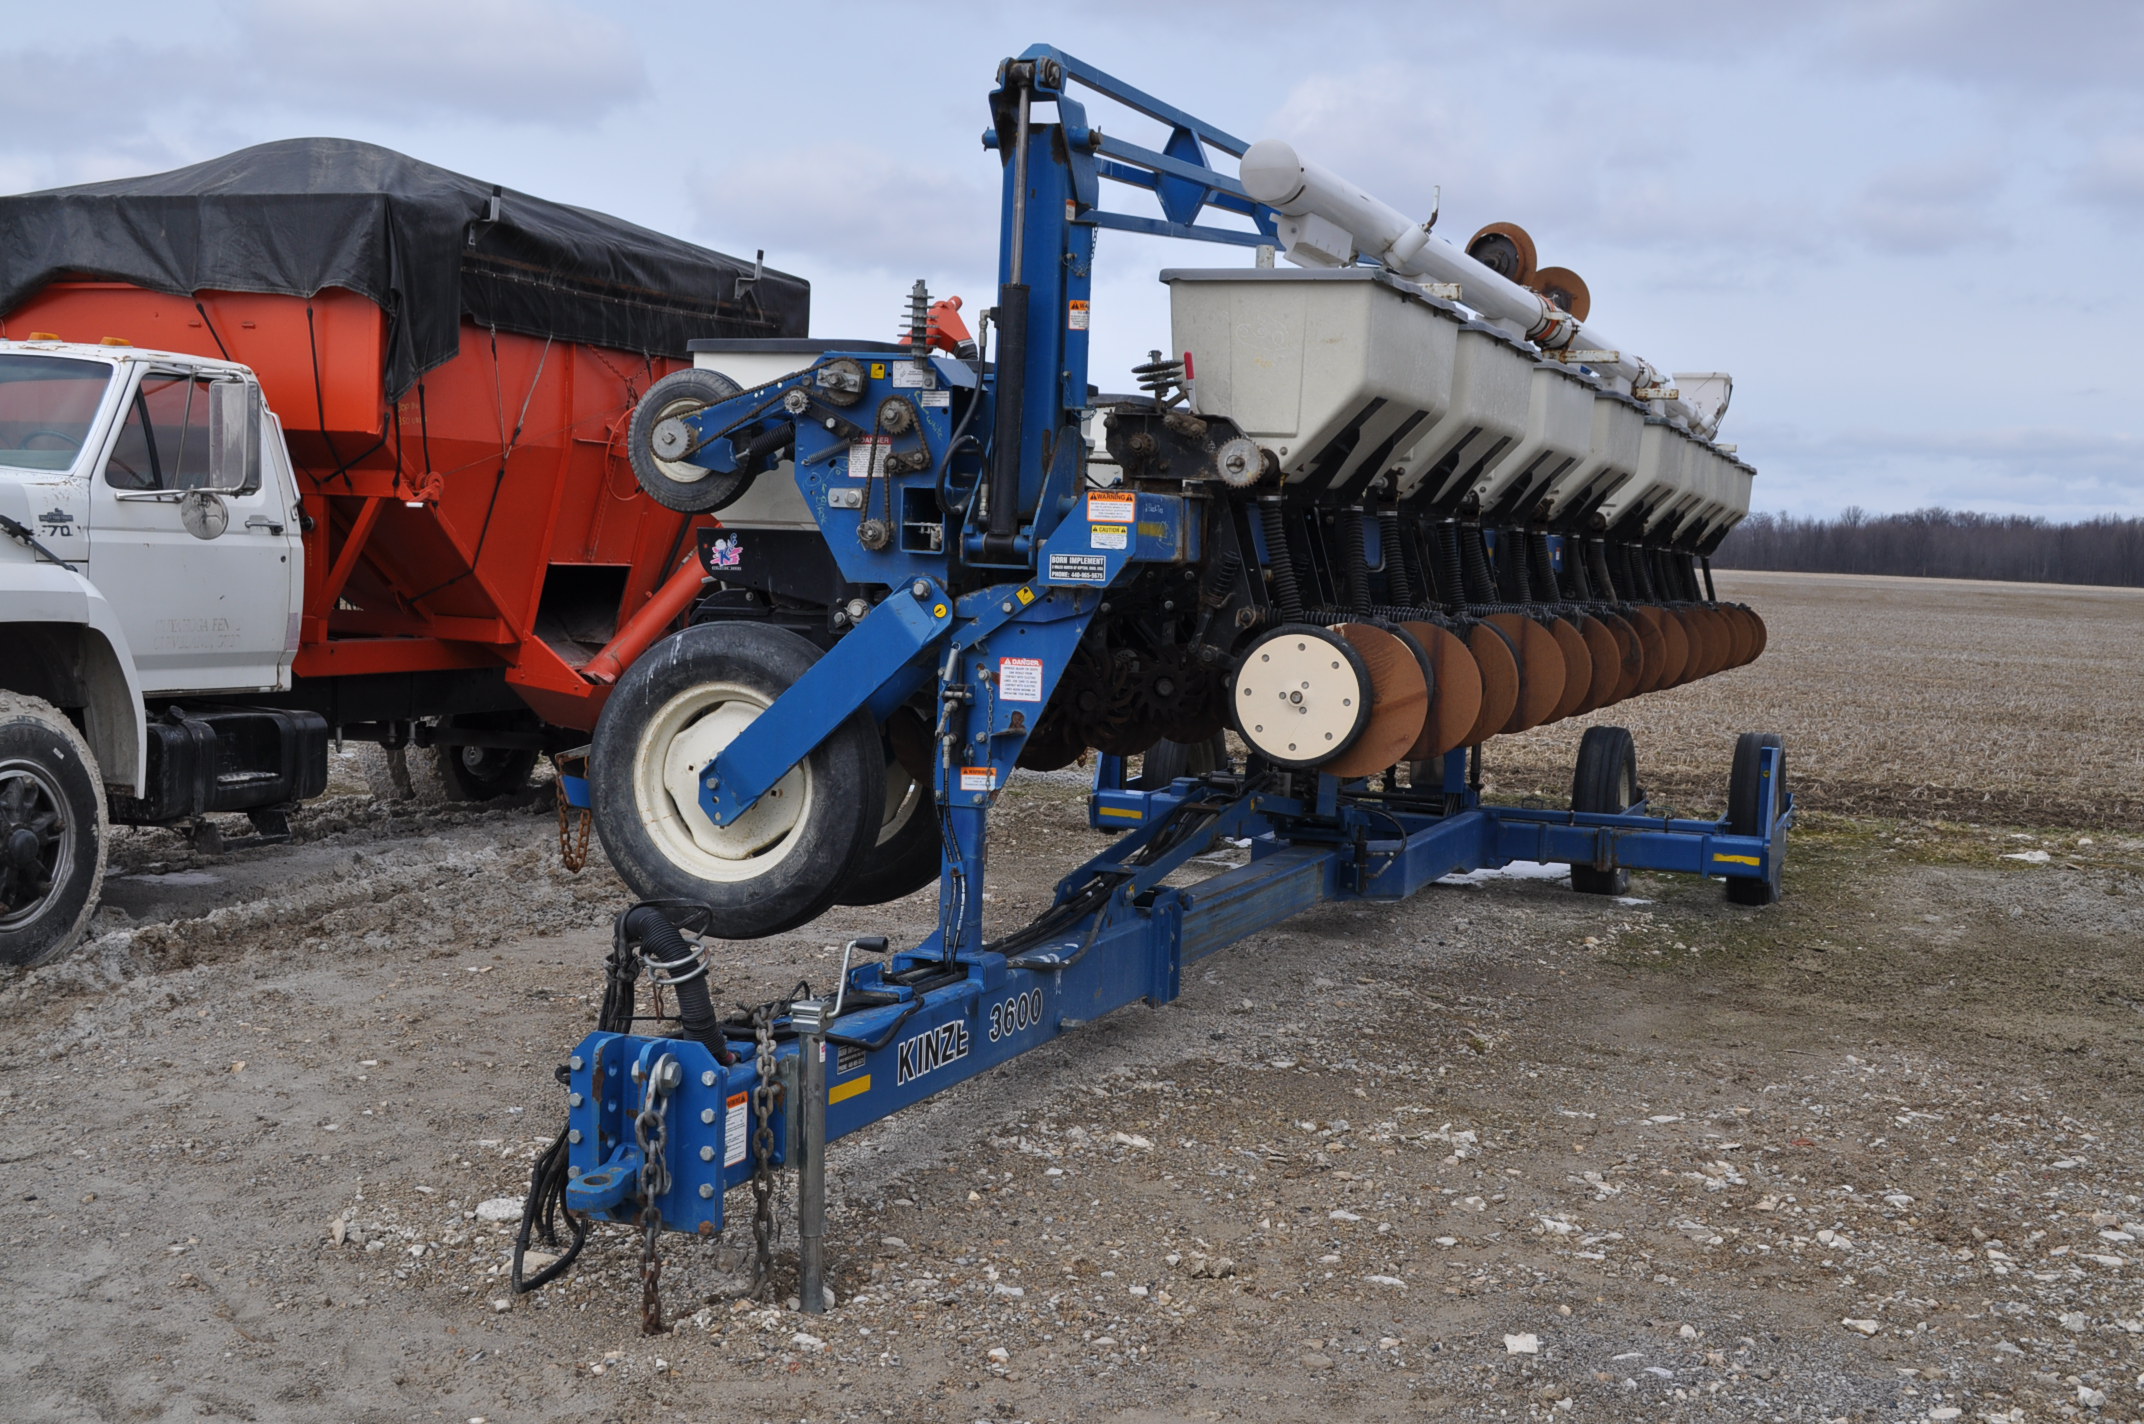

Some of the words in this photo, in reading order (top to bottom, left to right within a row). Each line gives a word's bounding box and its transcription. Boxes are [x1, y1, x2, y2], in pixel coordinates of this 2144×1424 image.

[1052, 556, 1068, 564] BORN
[1069, 557, 1104, 566] IMPLEMENT
[989, 987, 1043, 1042] 3600
[897, 1019, 969, 1087] KINZE
